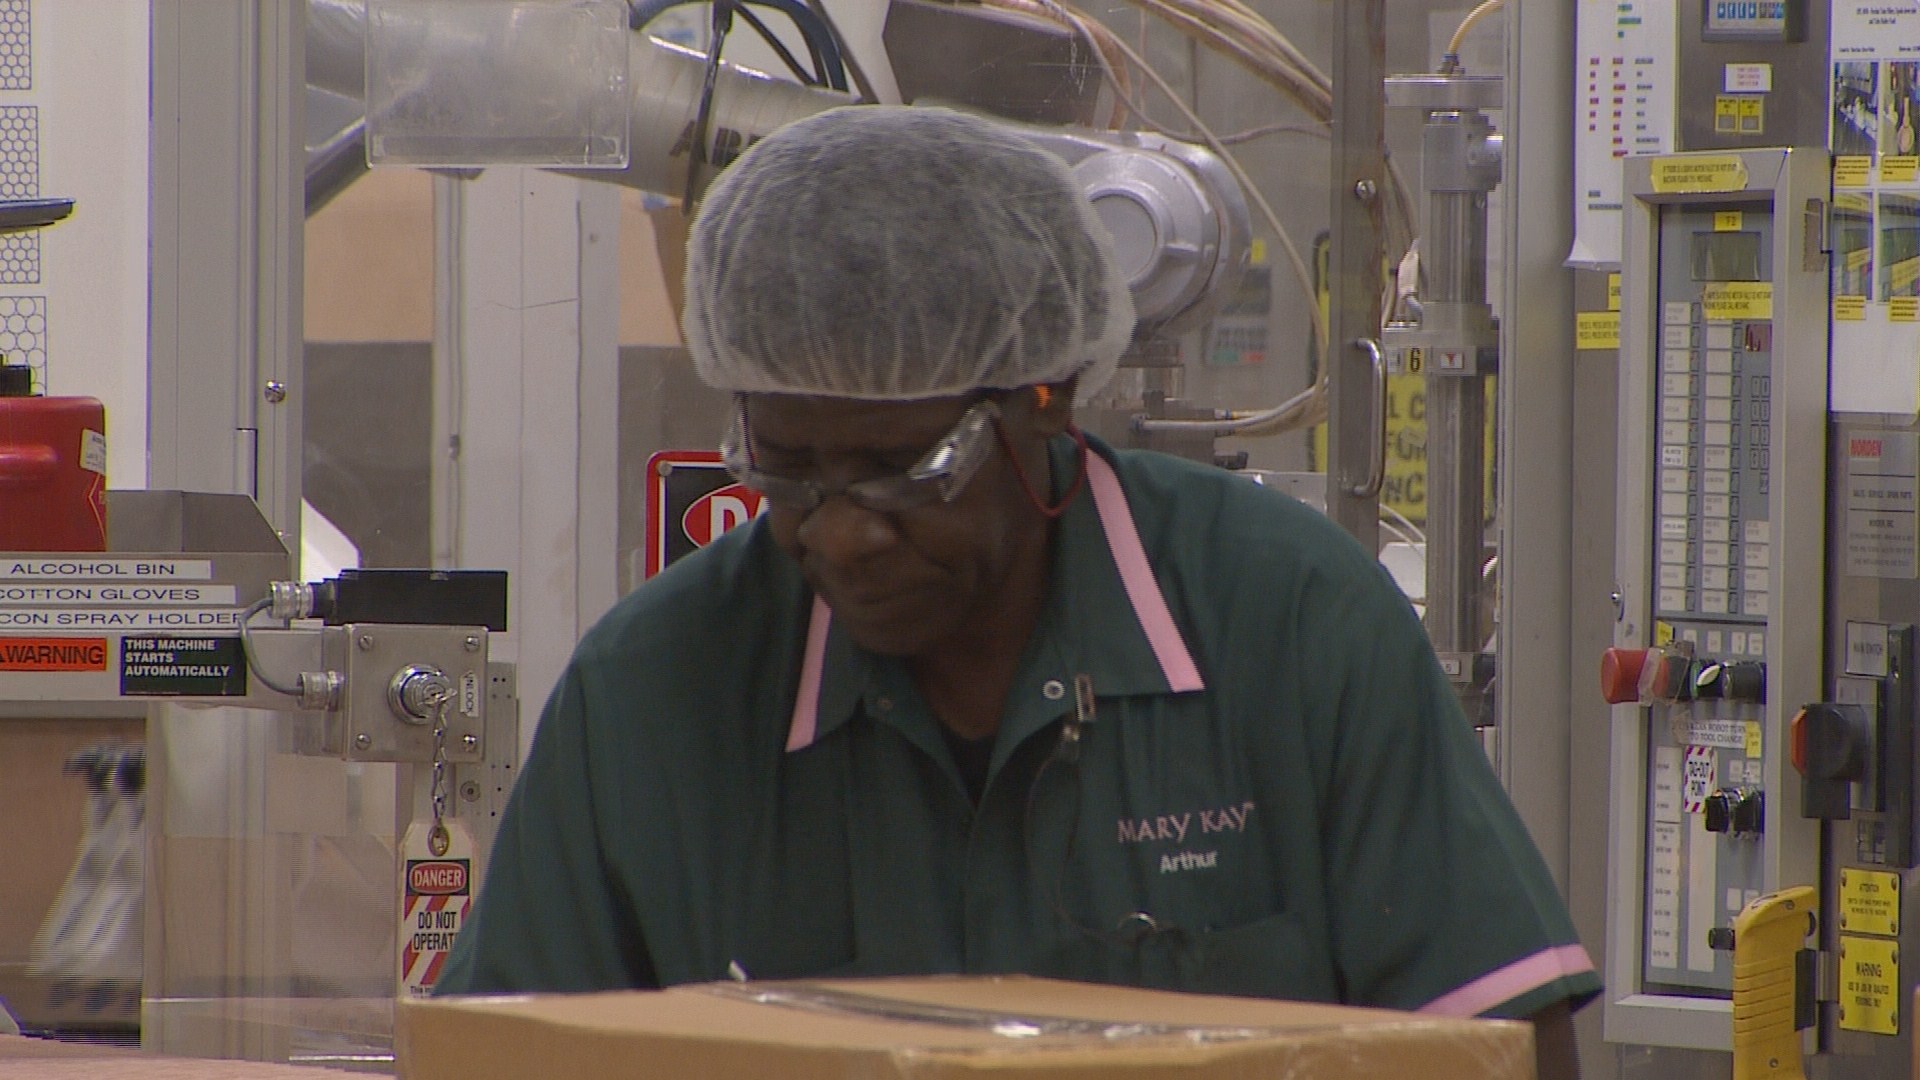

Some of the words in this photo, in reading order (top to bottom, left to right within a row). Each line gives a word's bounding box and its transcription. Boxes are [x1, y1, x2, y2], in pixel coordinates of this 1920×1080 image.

[1410, 348, 1421, 372] 6
[11, 563, 128, 575] ALCOHOL
[136, 563, 175, 575] BIN
[100, 588, 200, 600] GLOVES
[57, 613, 140, 625] SPRAY
[125, 640, 155, 650] THIS
[157, 640, 216, 650] MACHINE
[5, 646, 105, 665] WARNING
[125, 653, 174, 663] STARTS
[125, 666, 230, 677] AUTOMATICALLY
[1117, 812, 1191, 843] MARY
[1199, 805, 1250, 833] KAY
[1159, 851, 1218, 874] Arthur
[414, 869, 462, 887] DANGER
[418, 912, 432, 929] DO
[435, 912, 457, 929] NOT
[413, 933, 457, 951] OPERAT
